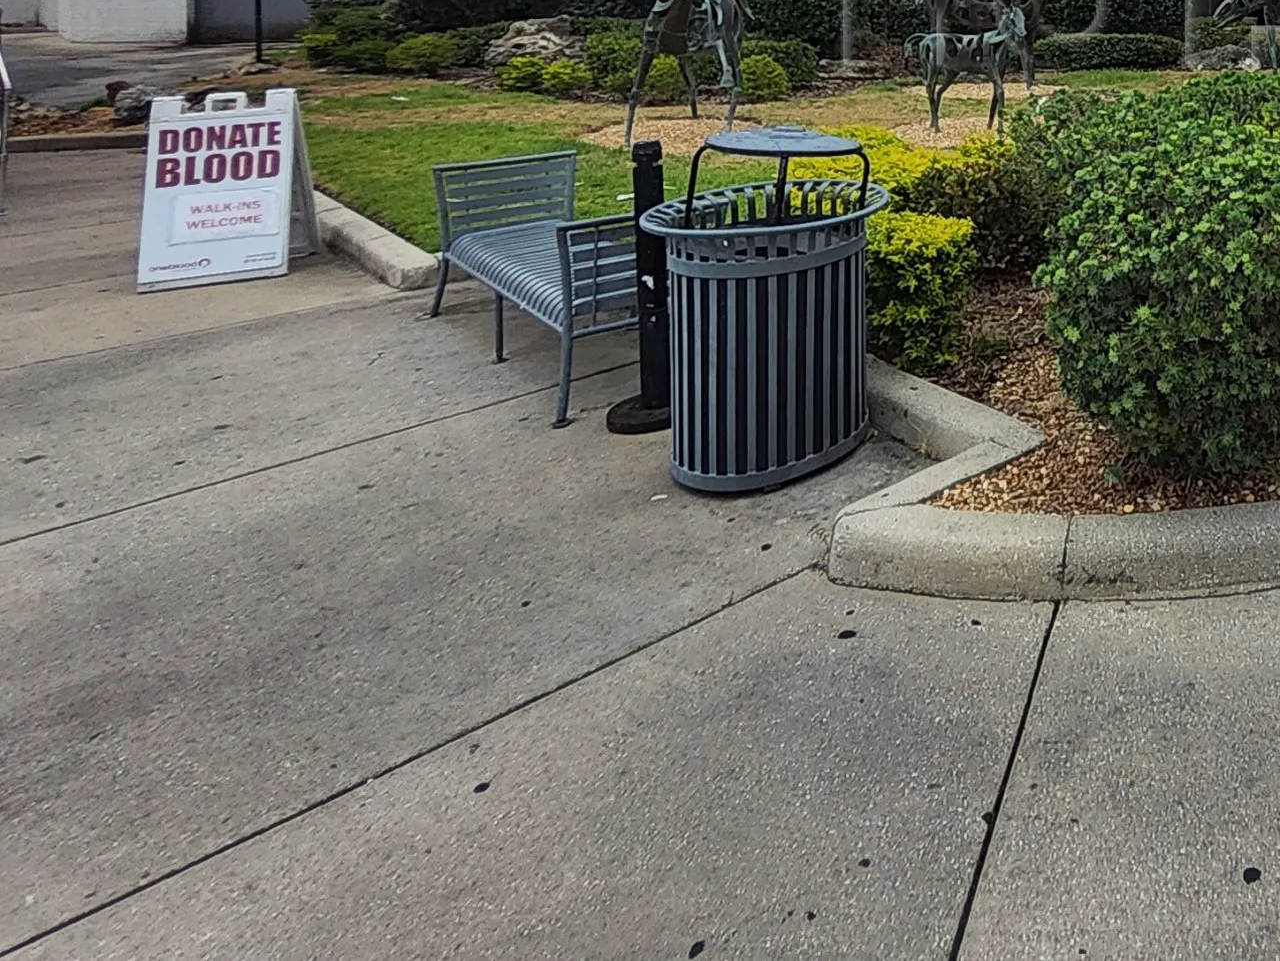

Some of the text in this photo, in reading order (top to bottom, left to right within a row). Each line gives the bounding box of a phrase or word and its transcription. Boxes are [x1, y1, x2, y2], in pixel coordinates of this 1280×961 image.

[157, 121, 282, 155] DONATE
[155, 149, 281, 189] BLOOD
[189, 199, 262, 214] WALK-INS
[186, 214, 263, 230] WELCOME
